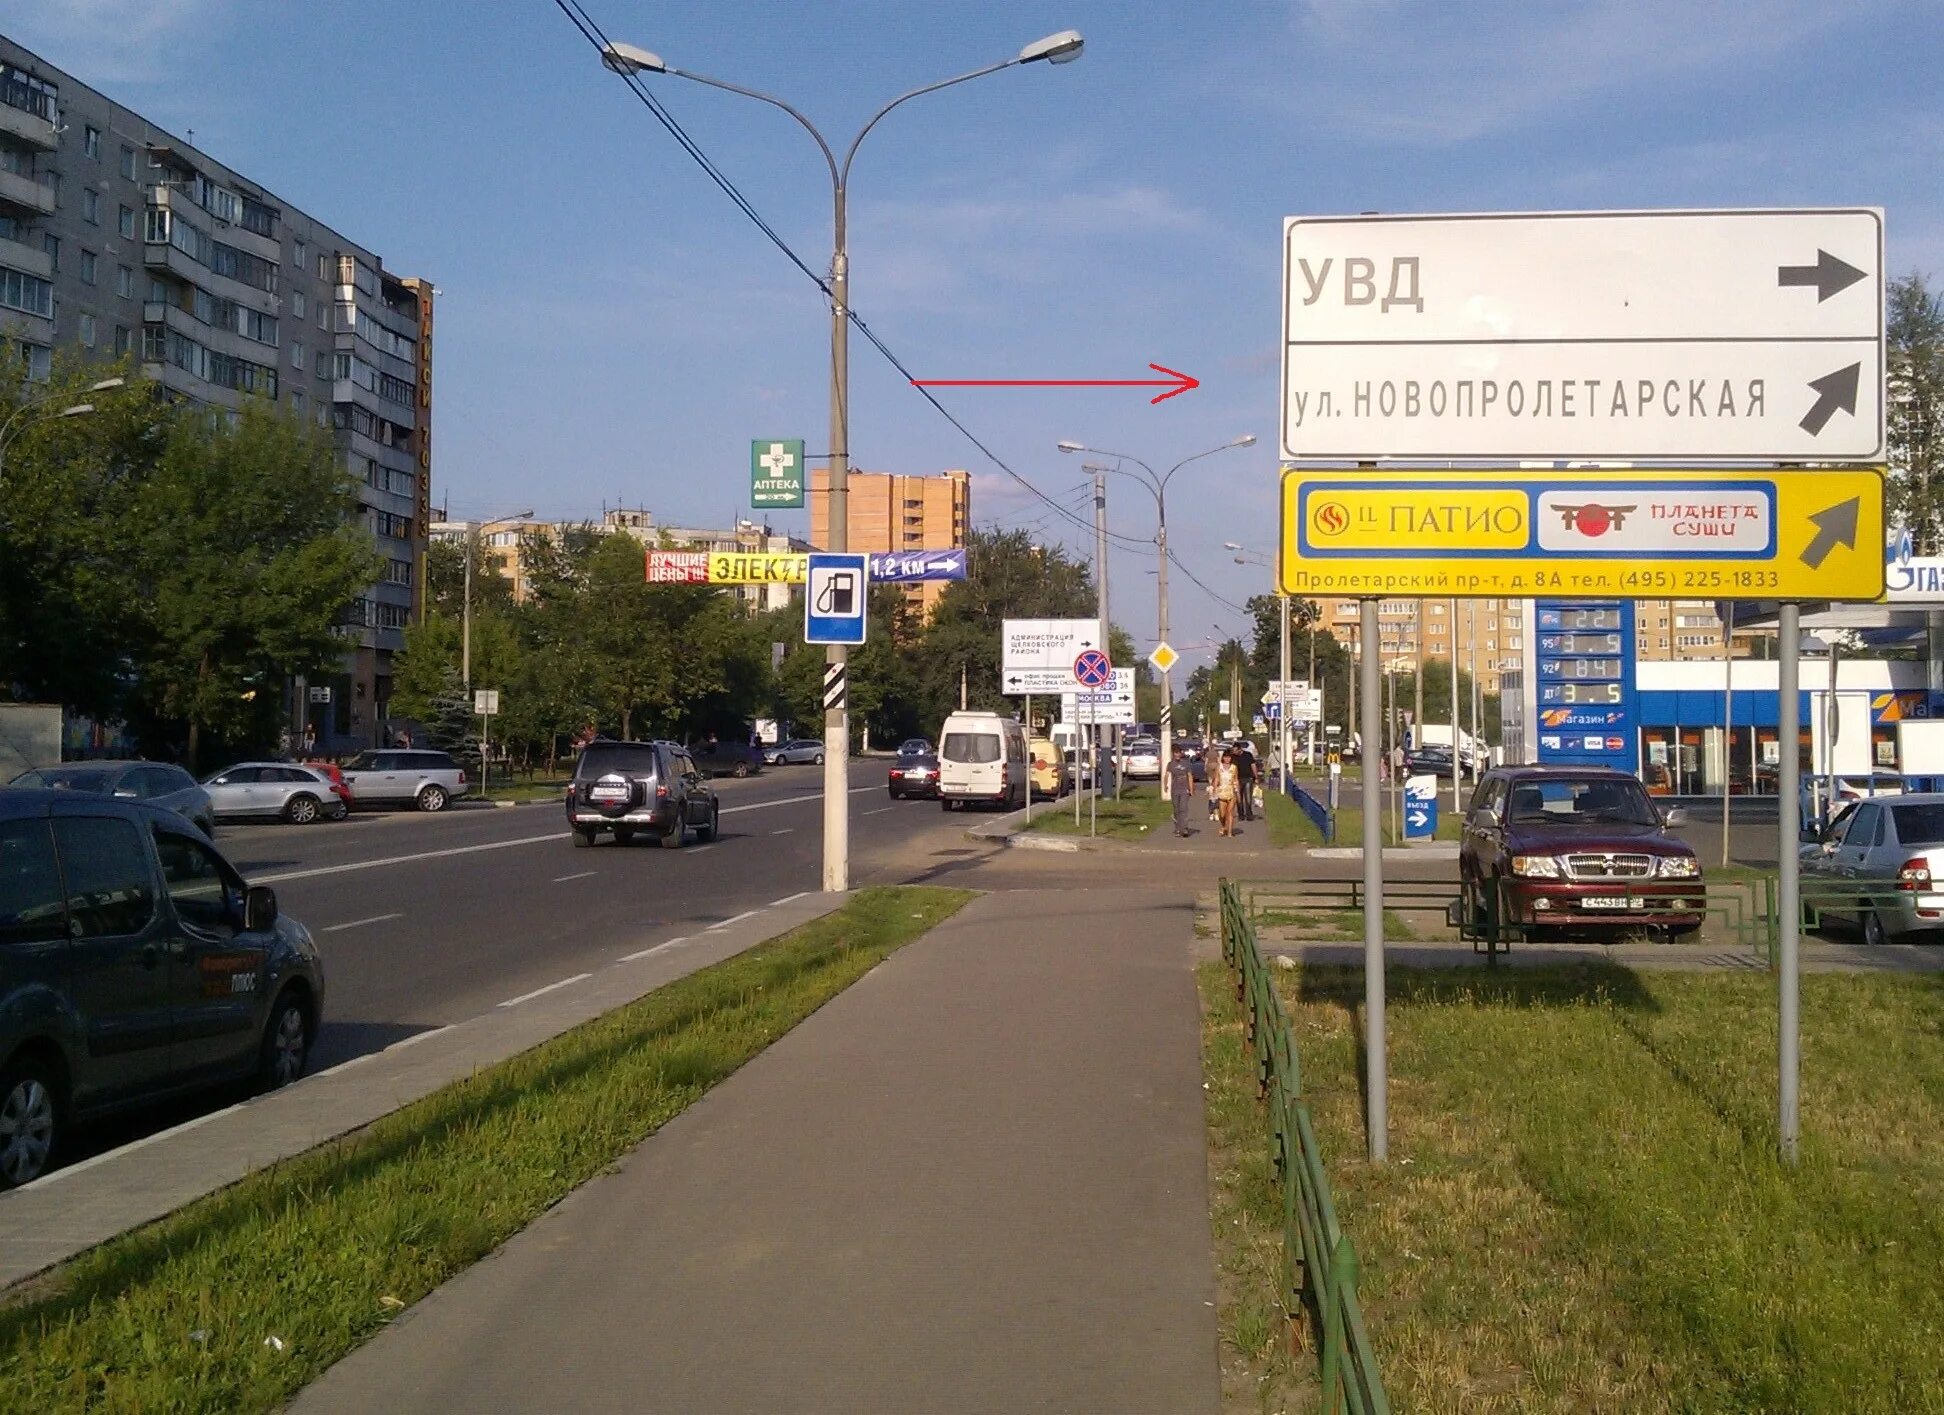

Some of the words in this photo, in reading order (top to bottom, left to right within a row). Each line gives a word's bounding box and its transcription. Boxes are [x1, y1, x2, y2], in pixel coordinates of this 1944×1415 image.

[1297, 256, 1425, 314] УВД
[1294, 391, 1342, 428] ул.
[1353, 377, 1767, 419] НОВОПРОЛЕТАРСКАЯ
[753, 479, 801, 490] АПТЕКА
[1389, 505, 1522, 534] ПАТИО
[1650, 503, 1759, 520] ПЛАНЕТА
[1672, 521, 1736, 537] СУШИ
[649, 553, 708, 568] ЛУЧШИЕ
[870, 557, 896, 579] 1,2
[1295, 571, 1449, 591] Пролетарский
[1511, 574, 1529, 589] д.
[1570, 574, 1611, 588] тел.
[1618, 571, 1677, 590] (495)
[1683, 571, 1779, 588] 225-1833
